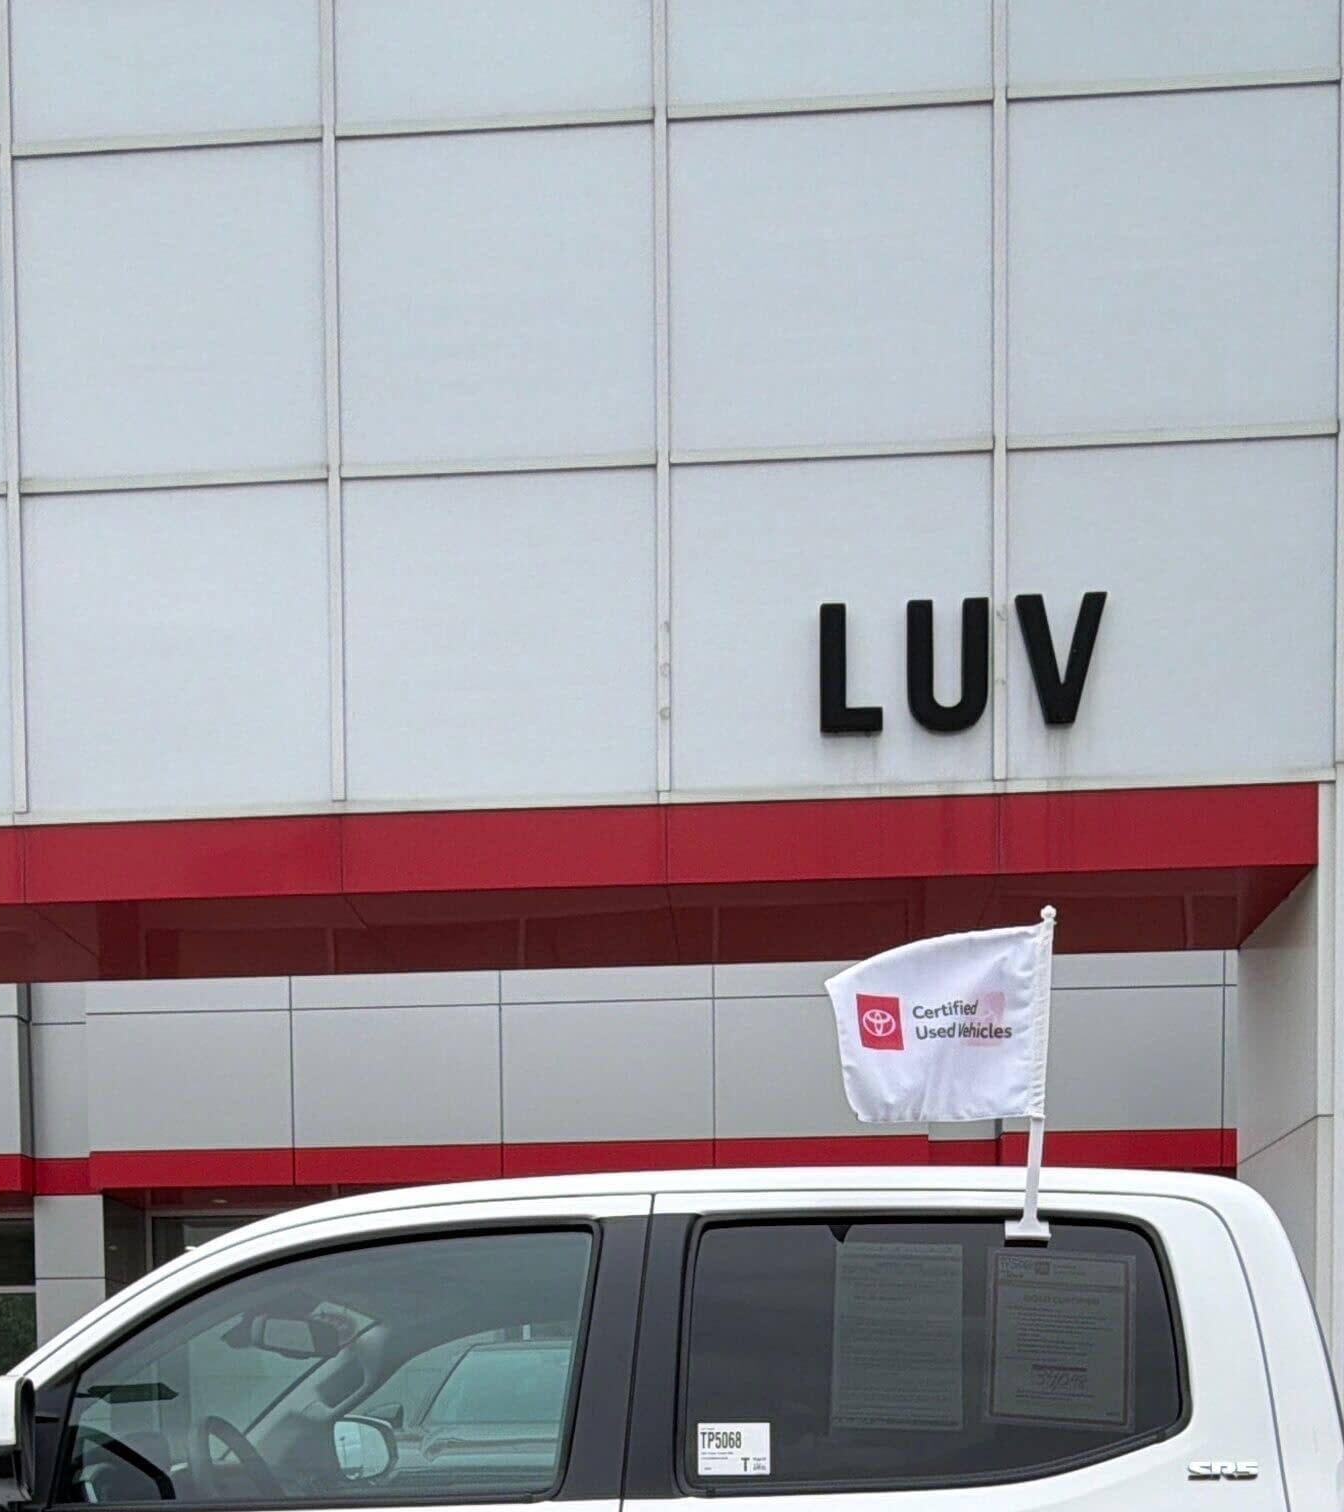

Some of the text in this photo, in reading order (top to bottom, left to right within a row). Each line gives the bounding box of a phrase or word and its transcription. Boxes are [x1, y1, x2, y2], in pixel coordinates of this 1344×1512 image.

[820, 592, 1107, 731] LUV
[912, 1000, 978, 1019] Certified
[916, 1023, 1012, 1040] Used Vehicles
[700, 1431, 742, 1449] TP5068
[740, 1457, 750, 1472] T
